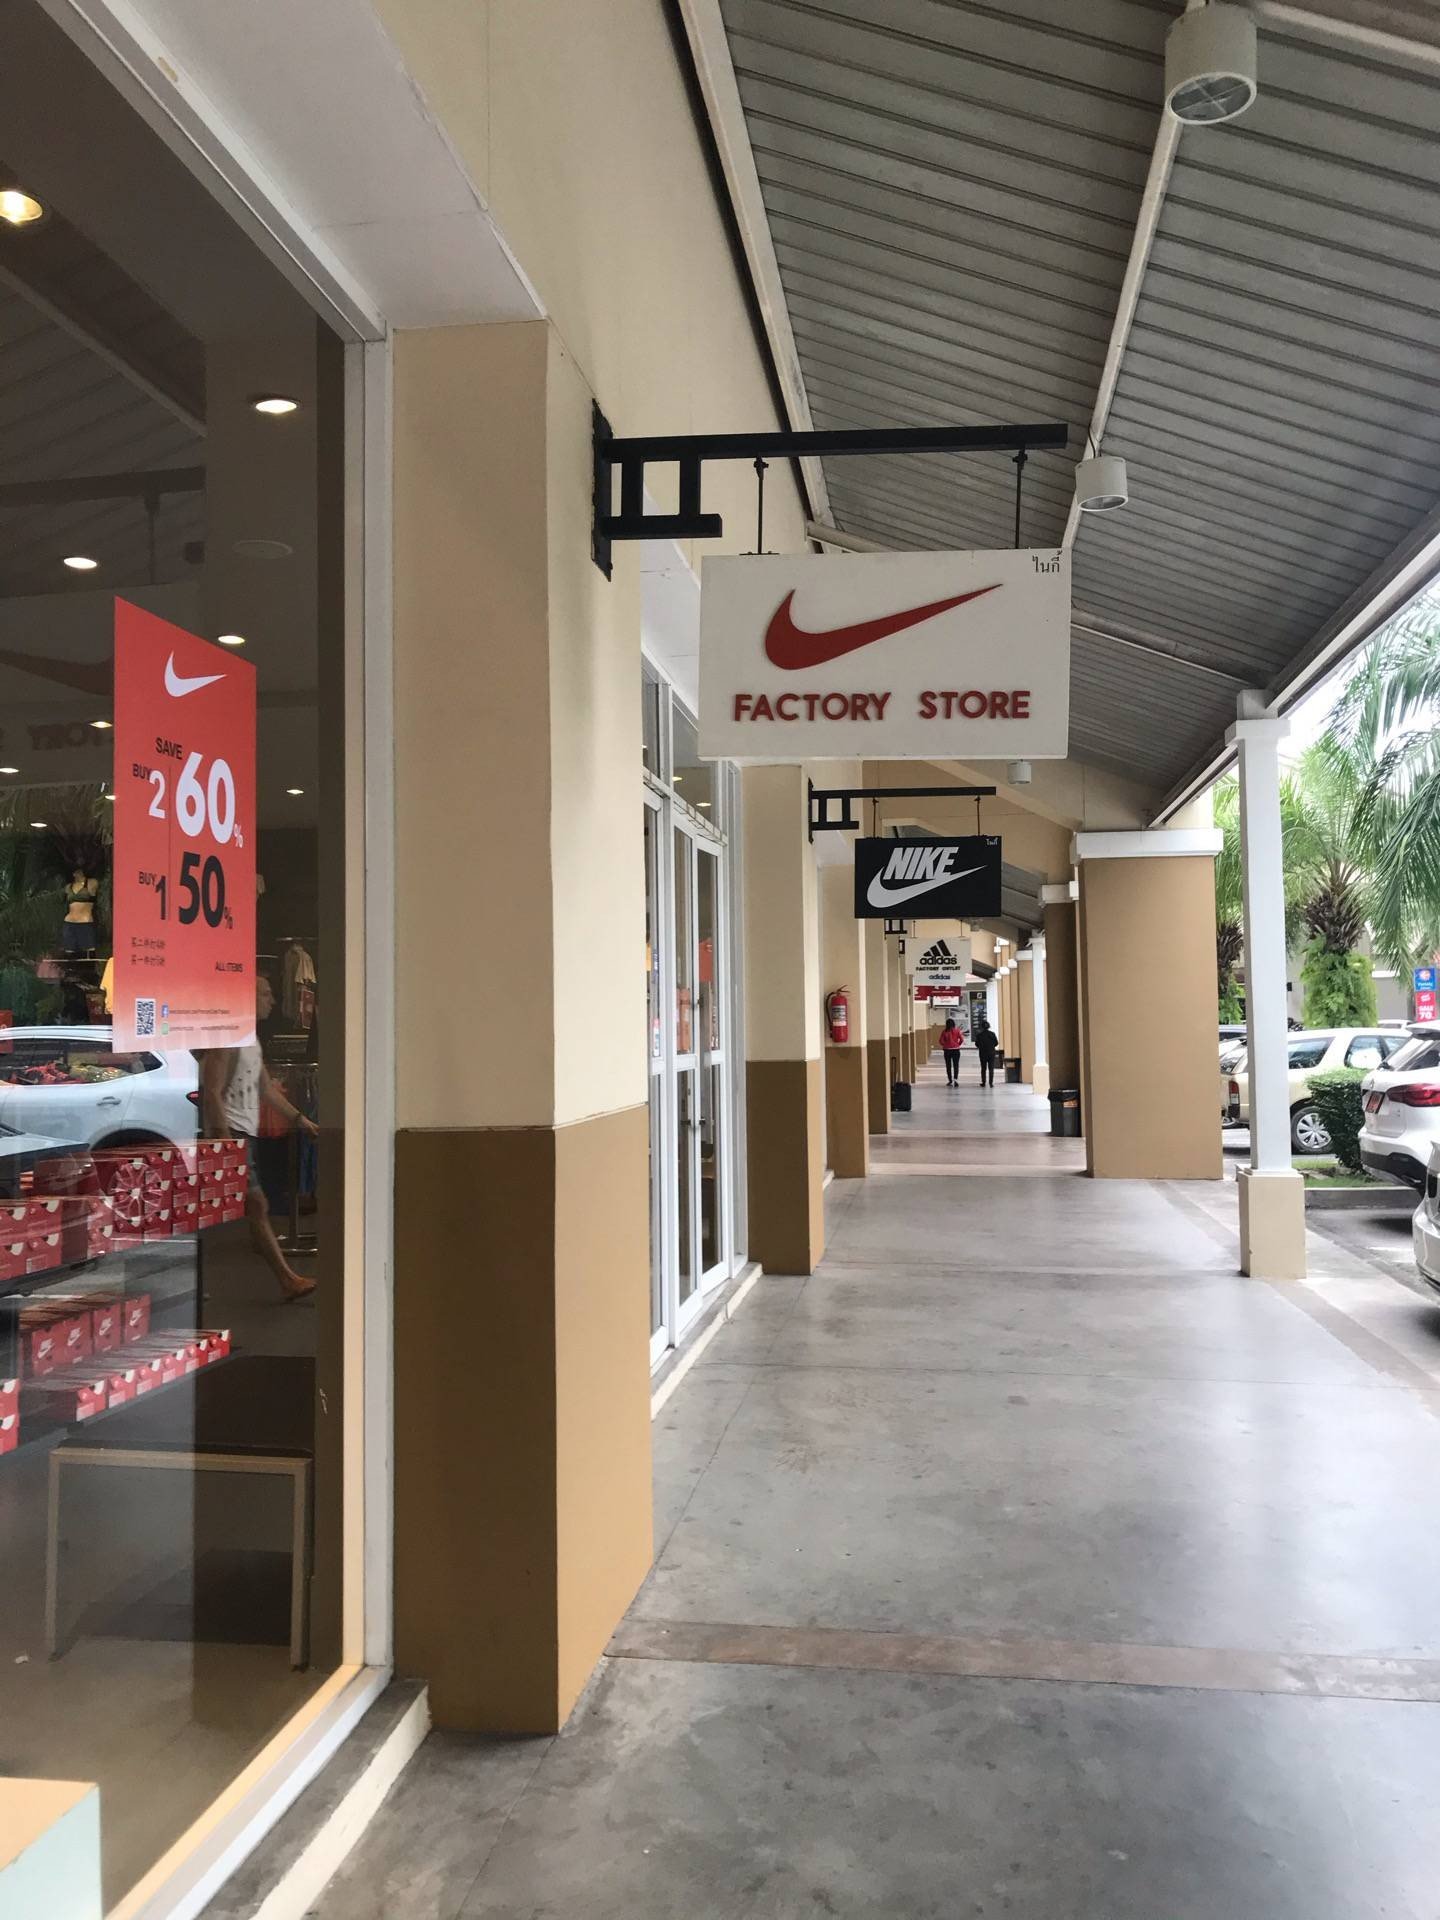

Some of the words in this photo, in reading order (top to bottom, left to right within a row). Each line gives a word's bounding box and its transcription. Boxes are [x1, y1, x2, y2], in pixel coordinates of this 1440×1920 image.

[1032, 549, 1063, 573] ไนกี้
[733, 691, 892, 722] FACTORY
[918, 690, 1031, 719] STORE
[155, 736, 183, 760] SAVE
[132, 762, 152, 781] BUY
[148, 769, 166, 819] 2
[882, 846, 960, 880] NIKE
[138, 870, 156, 887] BUY
[154, 875, 167, 921] 1
[919, 955, 957, 966] adidas
